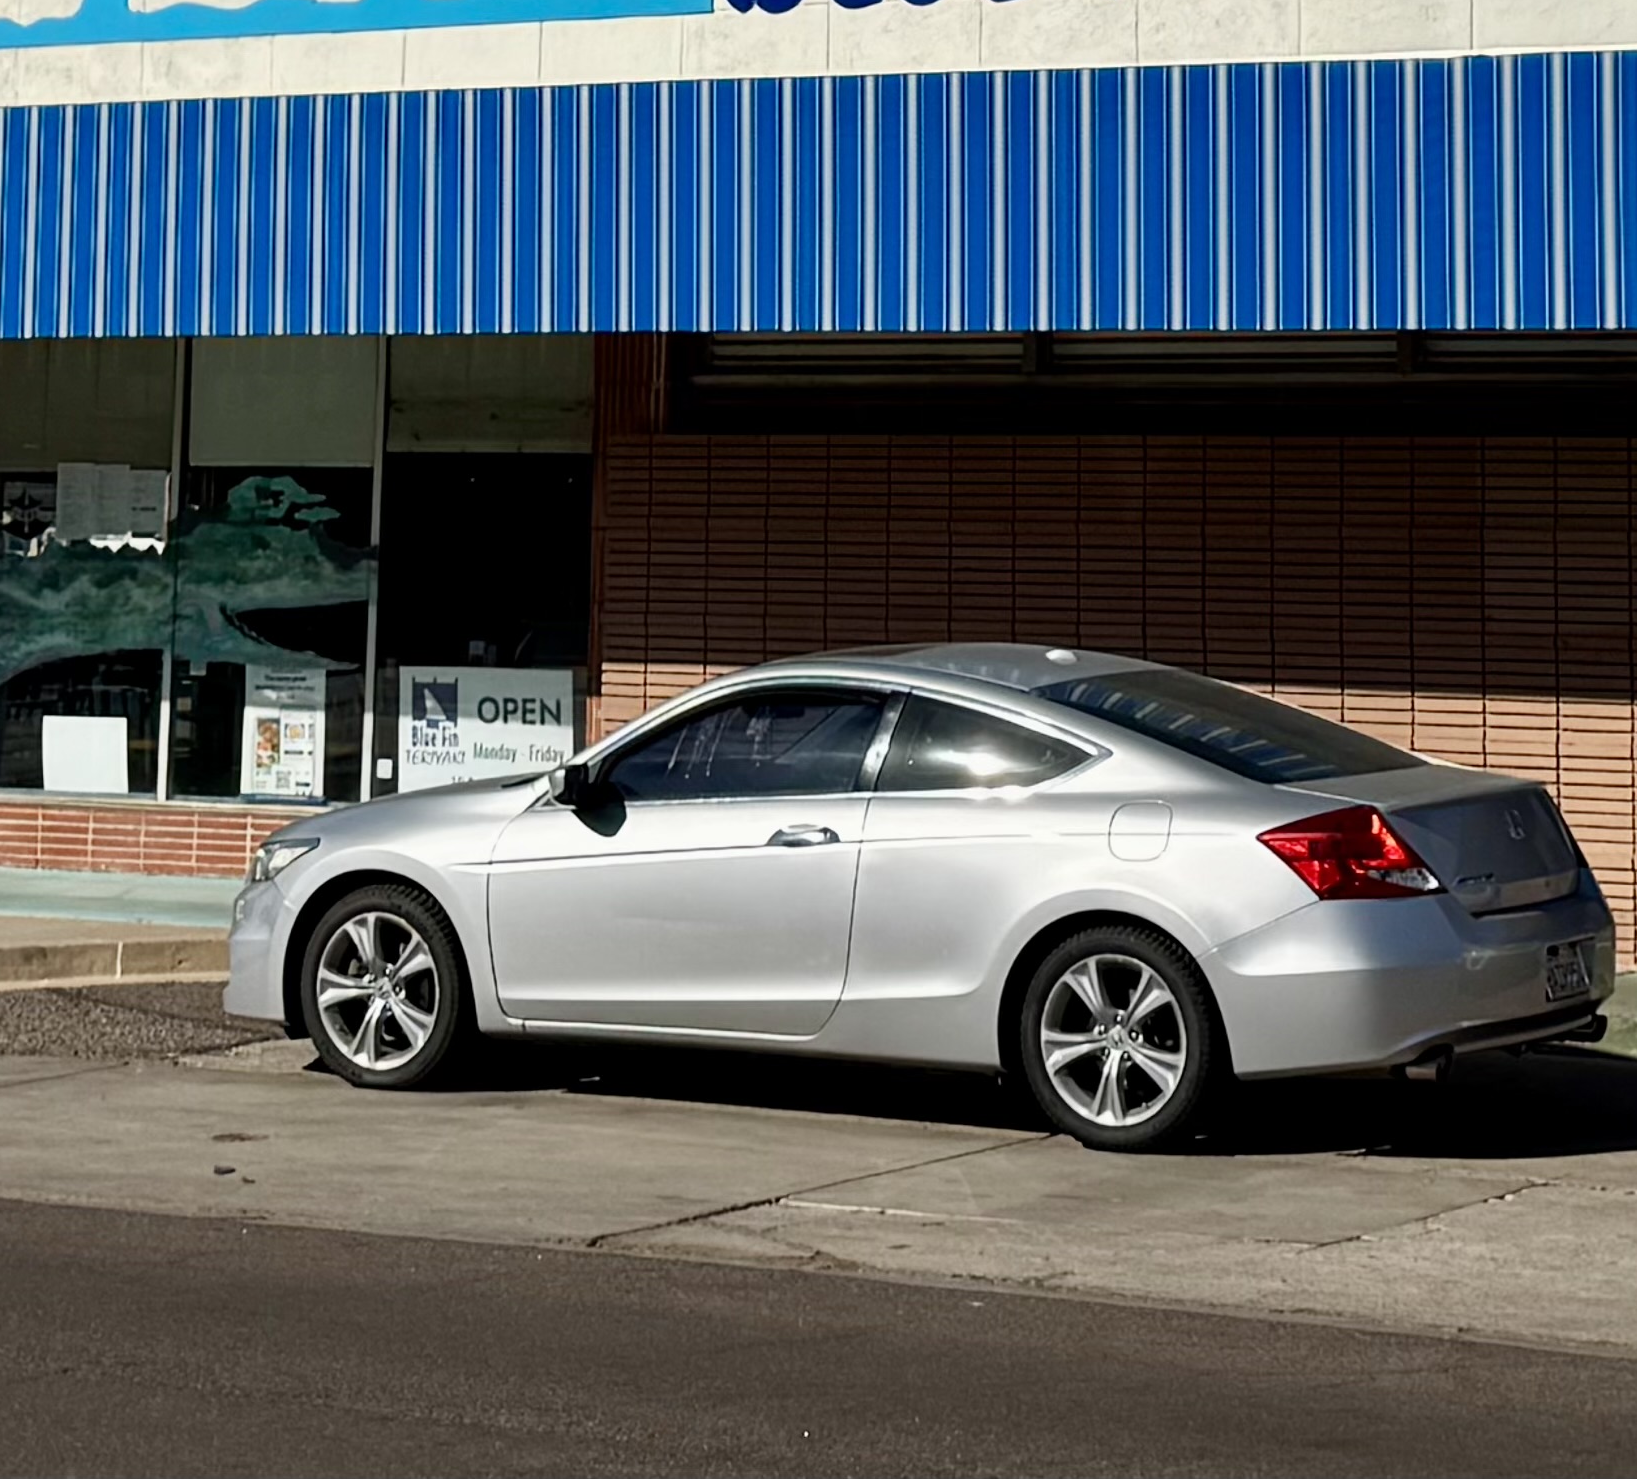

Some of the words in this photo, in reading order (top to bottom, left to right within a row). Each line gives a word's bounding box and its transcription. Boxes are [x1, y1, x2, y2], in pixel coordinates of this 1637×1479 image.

[477, 696, 562, 726] OPEN
[412, 725, 437, 747] Blue
[442, 726, 460, 747] Fin
[473, 742, 517, 763] Monday
[529, 744, 565, 765] Friday
